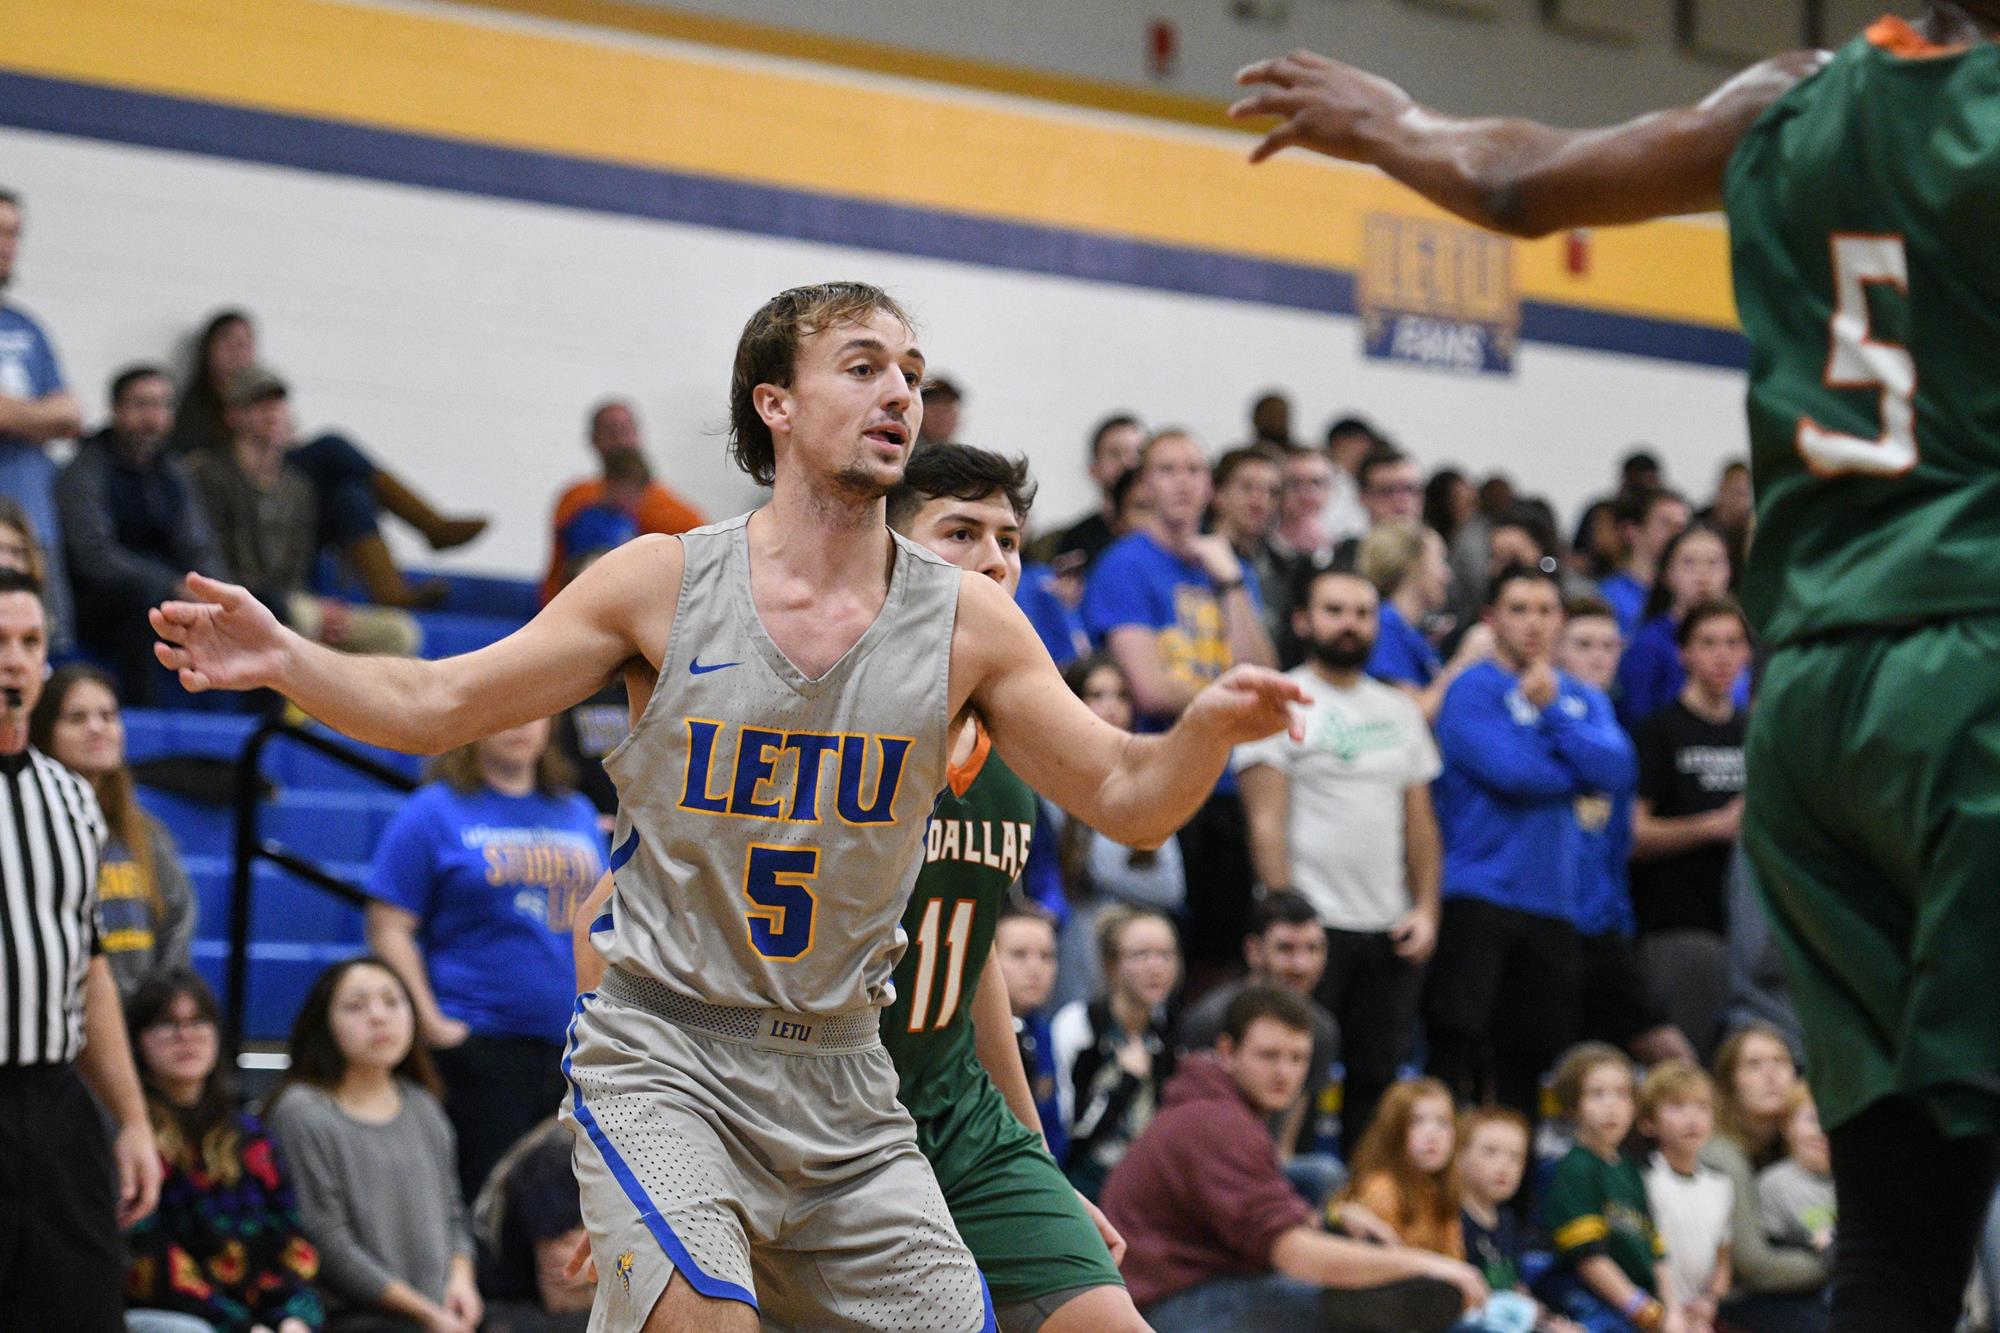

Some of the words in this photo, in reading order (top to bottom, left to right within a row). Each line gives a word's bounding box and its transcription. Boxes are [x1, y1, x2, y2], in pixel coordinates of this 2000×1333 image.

[1794, 230, 1921, 479] 5
[676, 716, 917, 827] LETU
[744, 841, 821, 962] 5
[907, 897, 976, 1033] 11
[770, 1019, 812, 1042] LETU
